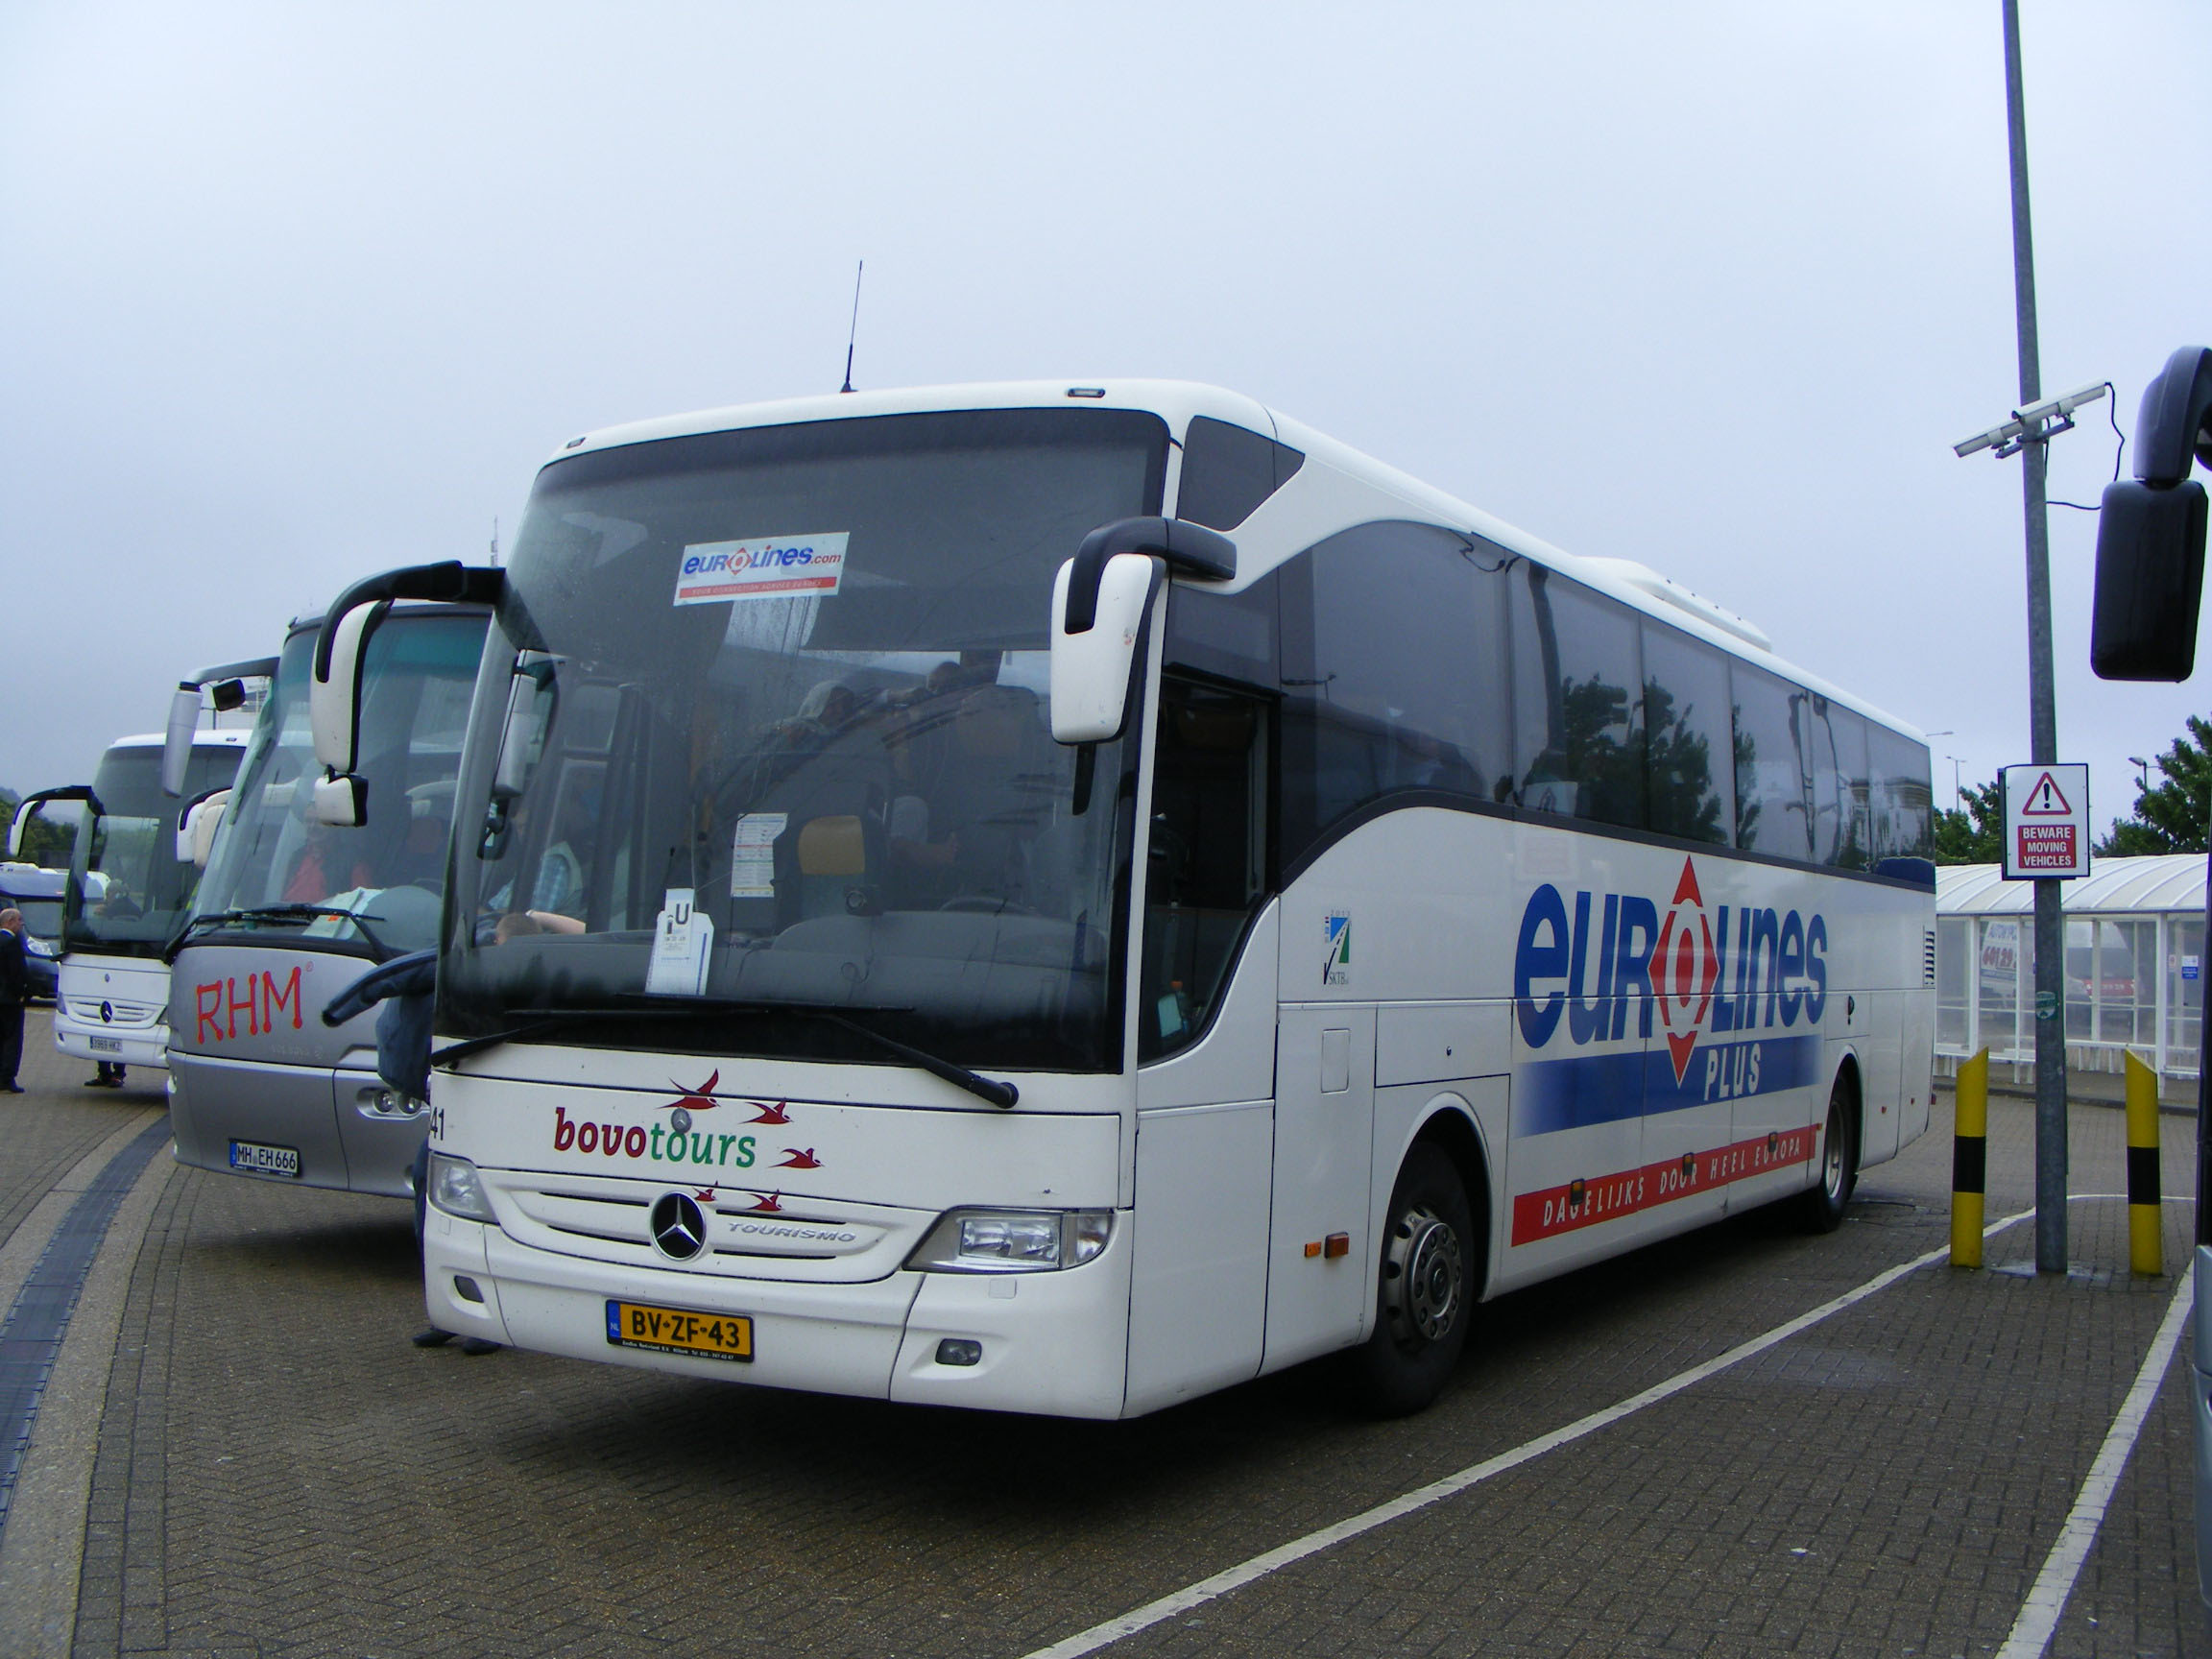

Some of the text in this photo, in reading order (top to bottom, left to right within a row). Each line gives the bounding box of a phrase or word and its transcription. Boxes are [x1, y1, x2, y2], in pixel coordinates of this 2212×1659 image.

[2023, 827, 2071, 839] BEWARE
[2024, 854, 2072, 867] VEHICLES
[2027, 841, 2067, 854] MOVING
[196, 966, 302, 1045] RHM
[1703, 1044, 1762, 1102] PLUS
[554, 1106, 757, 1168] bovotours
[237, 1145, 296, 1169] MH EH 666
[1710, 1150, 1745, 1181] HEEL
[729, 1222, 856, 1242] TOURISMO
[610, 1310, 740, 1348] NL BV-ZF-43
